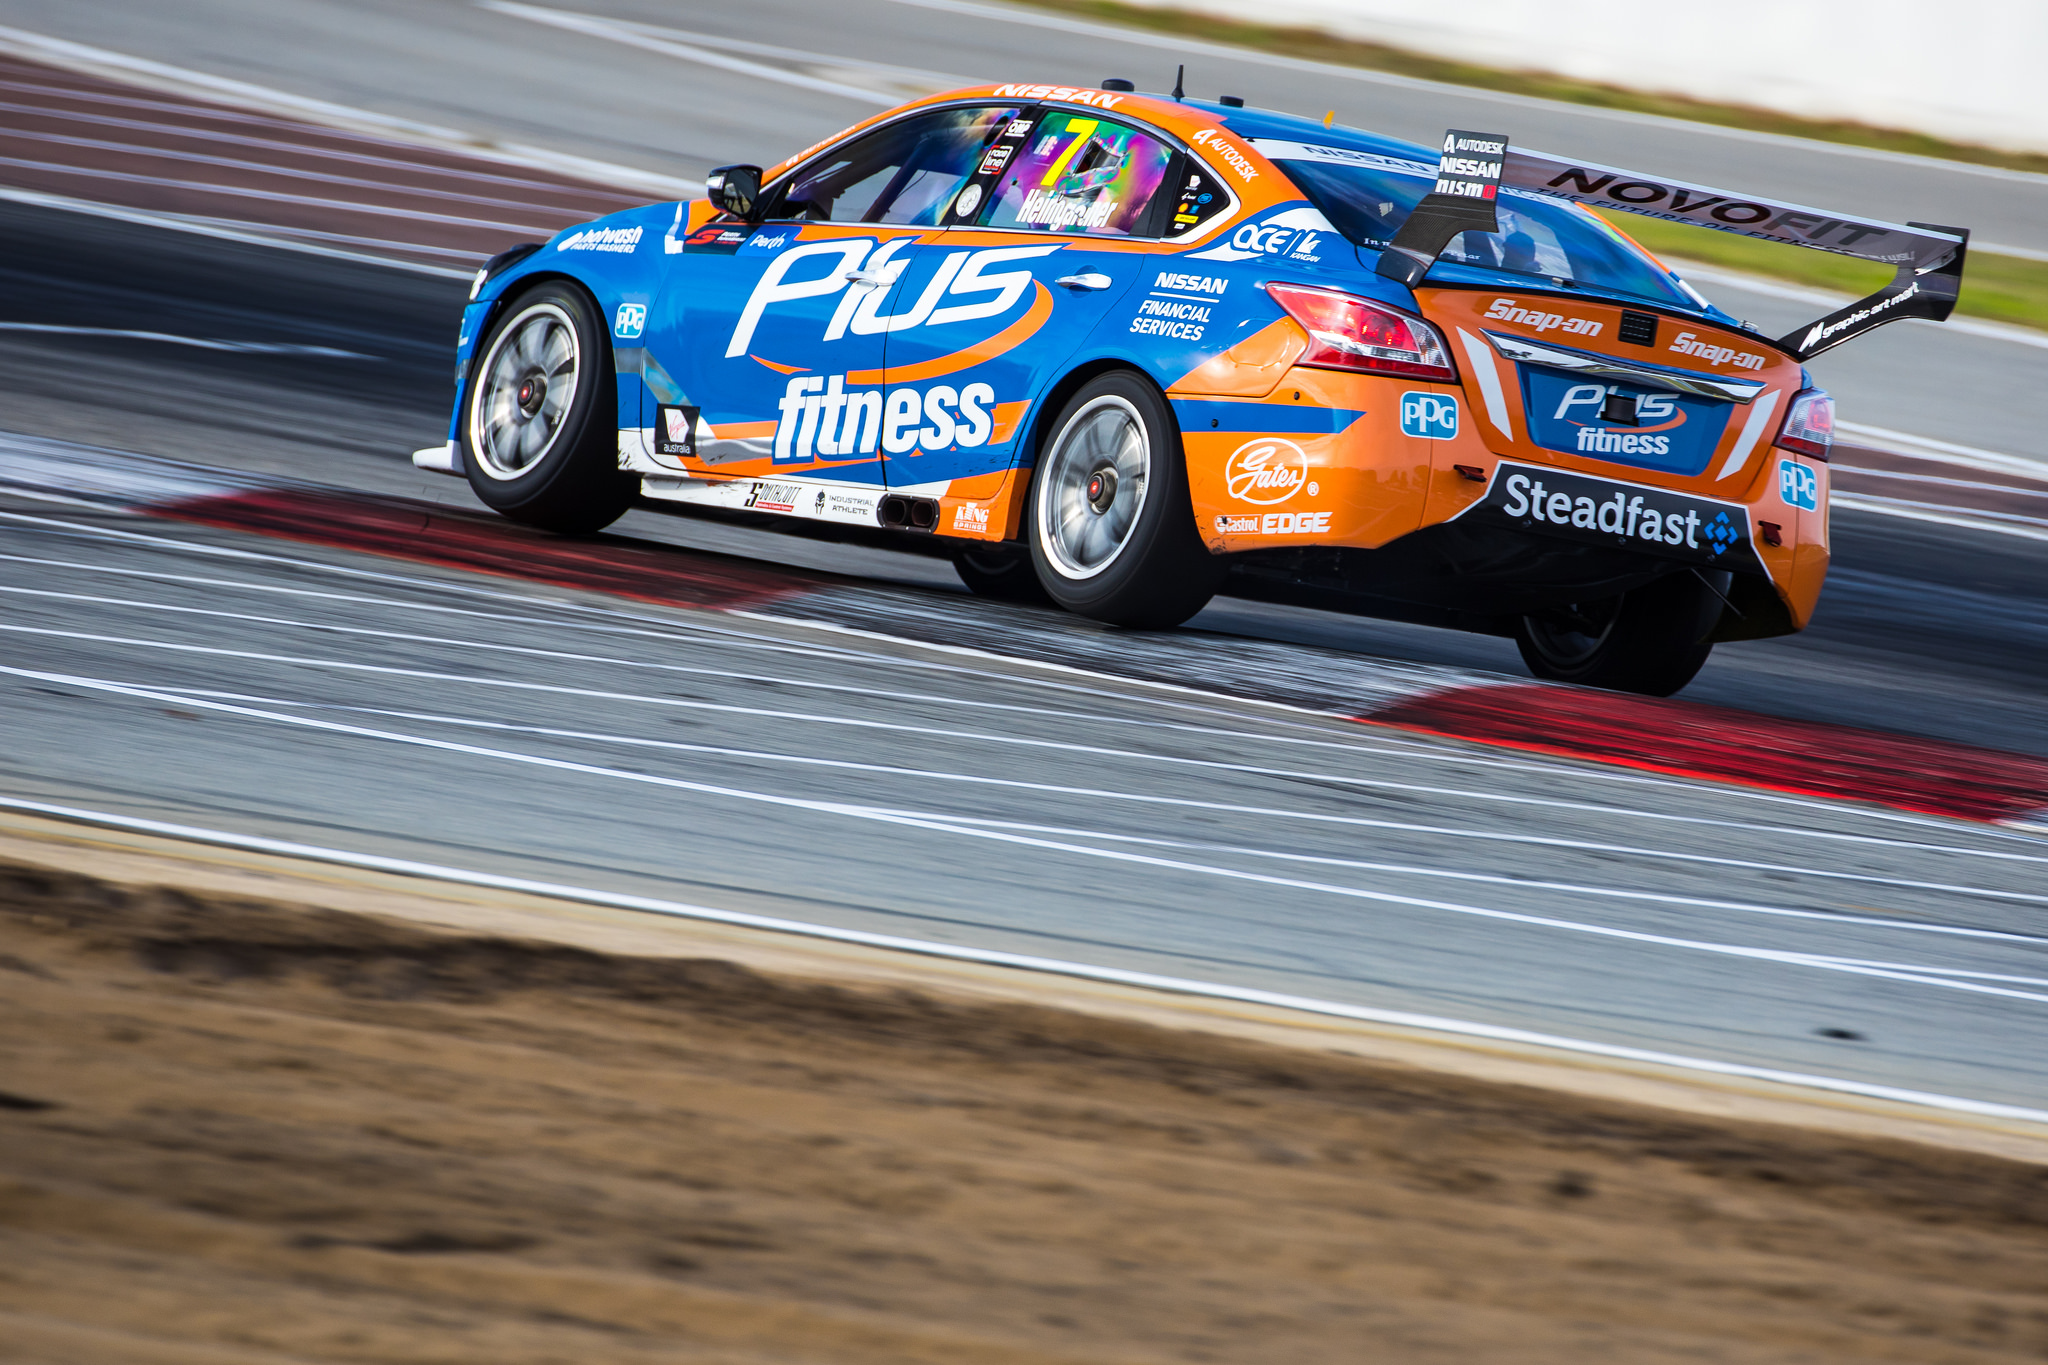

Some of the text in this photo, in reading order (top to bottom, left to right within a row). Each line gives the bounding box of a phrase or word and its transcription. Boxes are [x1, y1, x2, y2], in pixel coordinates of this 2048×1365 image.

[992, 83, 1124, 109] NISSAN
[1008, 122, 1031, 134] OMP
[1040, 118, 1100, 186] 7
[1301, 145, 1434, 173] NISSAN
[1455, 138, 1505, 155] AUTODESK
[1207, 137, 1260, 183] AUTODESK
[1439, 156, 1502, 179] NISSAN
[1434, 178, 1497, 199] nismo
[1547, 167, 1891, 247] NOVOFIT
[579, 225, 644, 245] hotwash
[749, 231, 788, 250] Perth
[570, 243, 637, 254] PARTS WASHERS
[1153, 271, 1229, 295] NISSAN
[724, 238, 1064, 359] Plus
[1138, 299, 1212, 323] FINANCIAL
[1821, 281, 1920, 339] graphic art mart
[616, 307, 643, 334] PPG
[1129, 317, 1205, 341] SERVICES
[1483, 298, 1604, 337] Snap-on
[1668, 331, 1767, 371] Snap-on
[774, 374, 995, 459] fitness
[1404, 397, 1454, 433] PPG
[663, 443, 691, 455] australia
[1577, 426, 1670, 455] fitness
[1228, 445, 1303, 499] Gates
[1781, 466, 1817, 502] PPG
[829, 495, 875, 506] INDUSTRIAL
[832, 504, 869, 516] ATHLETE
[955, 501, 990, 523] KING
[1503, 473, 1701, 549] Steadfast
[953, 521, 988, 531] SPRINGS
[1226, 511, 1334, 534] Castrol EDGE
